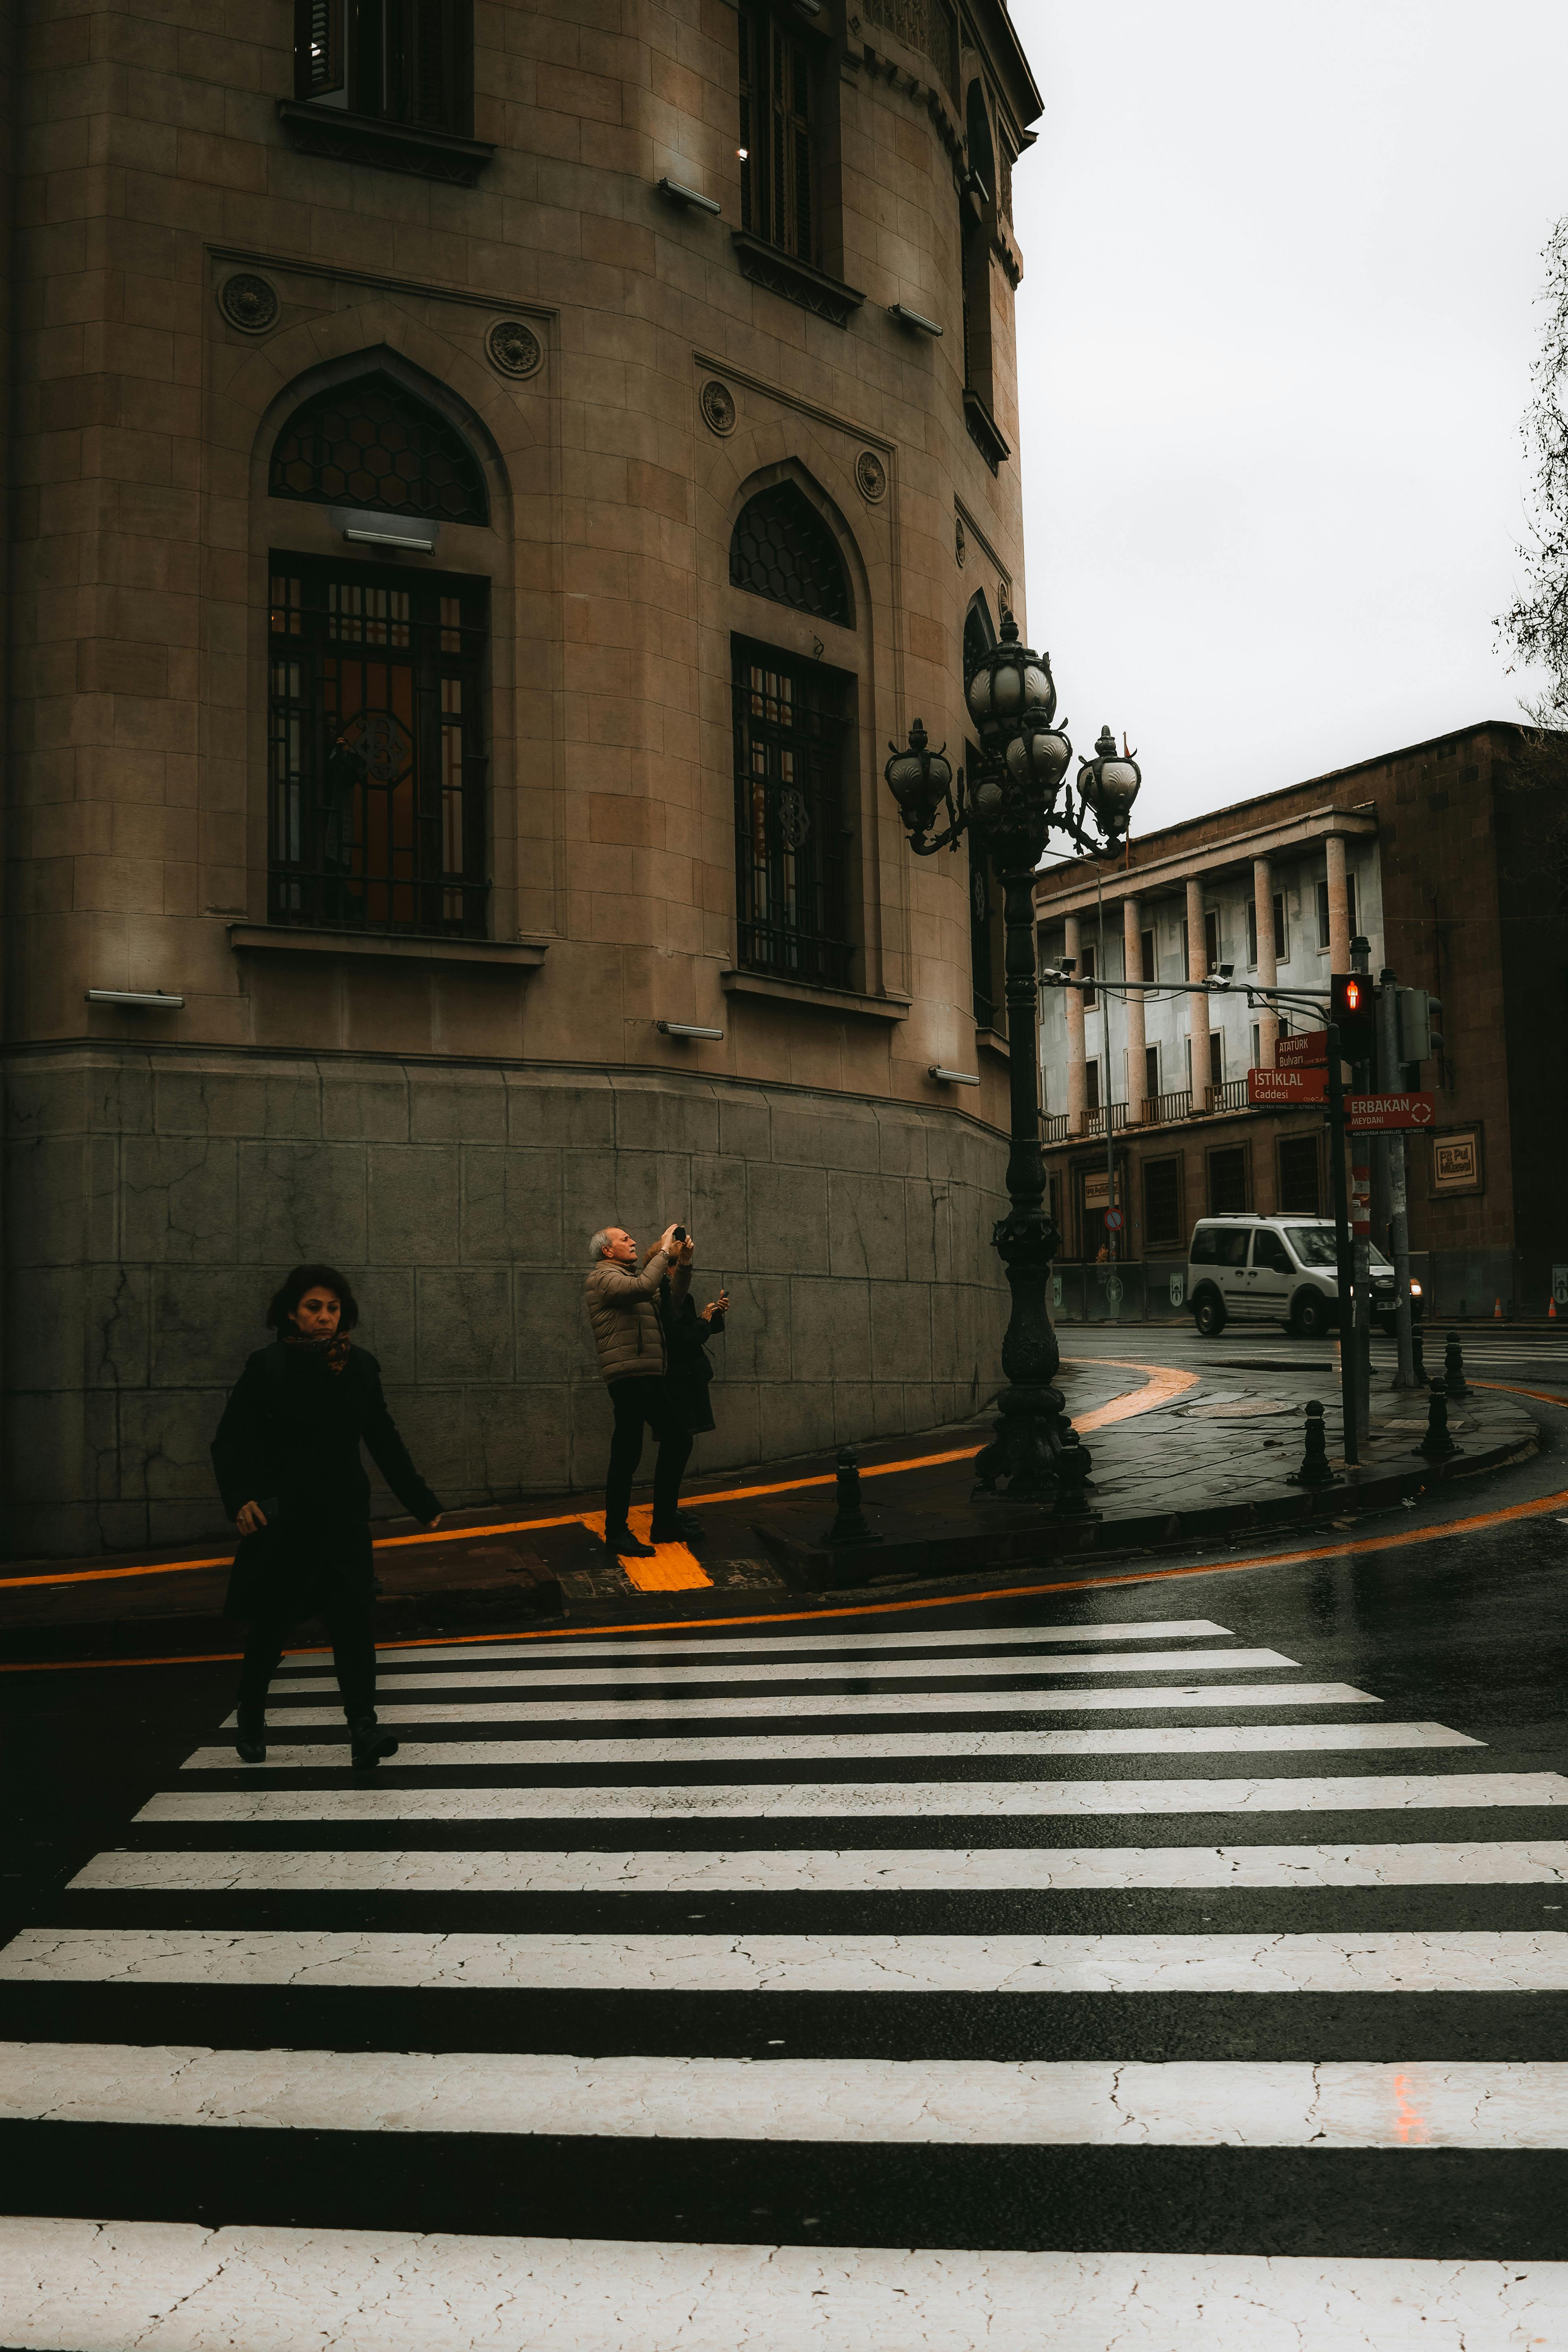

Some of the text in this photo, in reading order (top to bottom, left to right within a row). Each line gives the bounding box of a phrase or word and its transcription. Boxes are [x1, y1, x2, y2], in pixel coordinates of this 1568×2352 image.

[1279, 1037, 1308, 1053] ATATÜRK
[1280, 1055, 1303, 1067] Bulvarı
[1255, 1070, 1303, 1086] İSTİKLAL
[1255, 1089, 1288, 1099] Caddesi
[1351, 1099, 1409, 1114] ERBAKAN
[1352, 1117, 1384, 1125] MEYDANI
